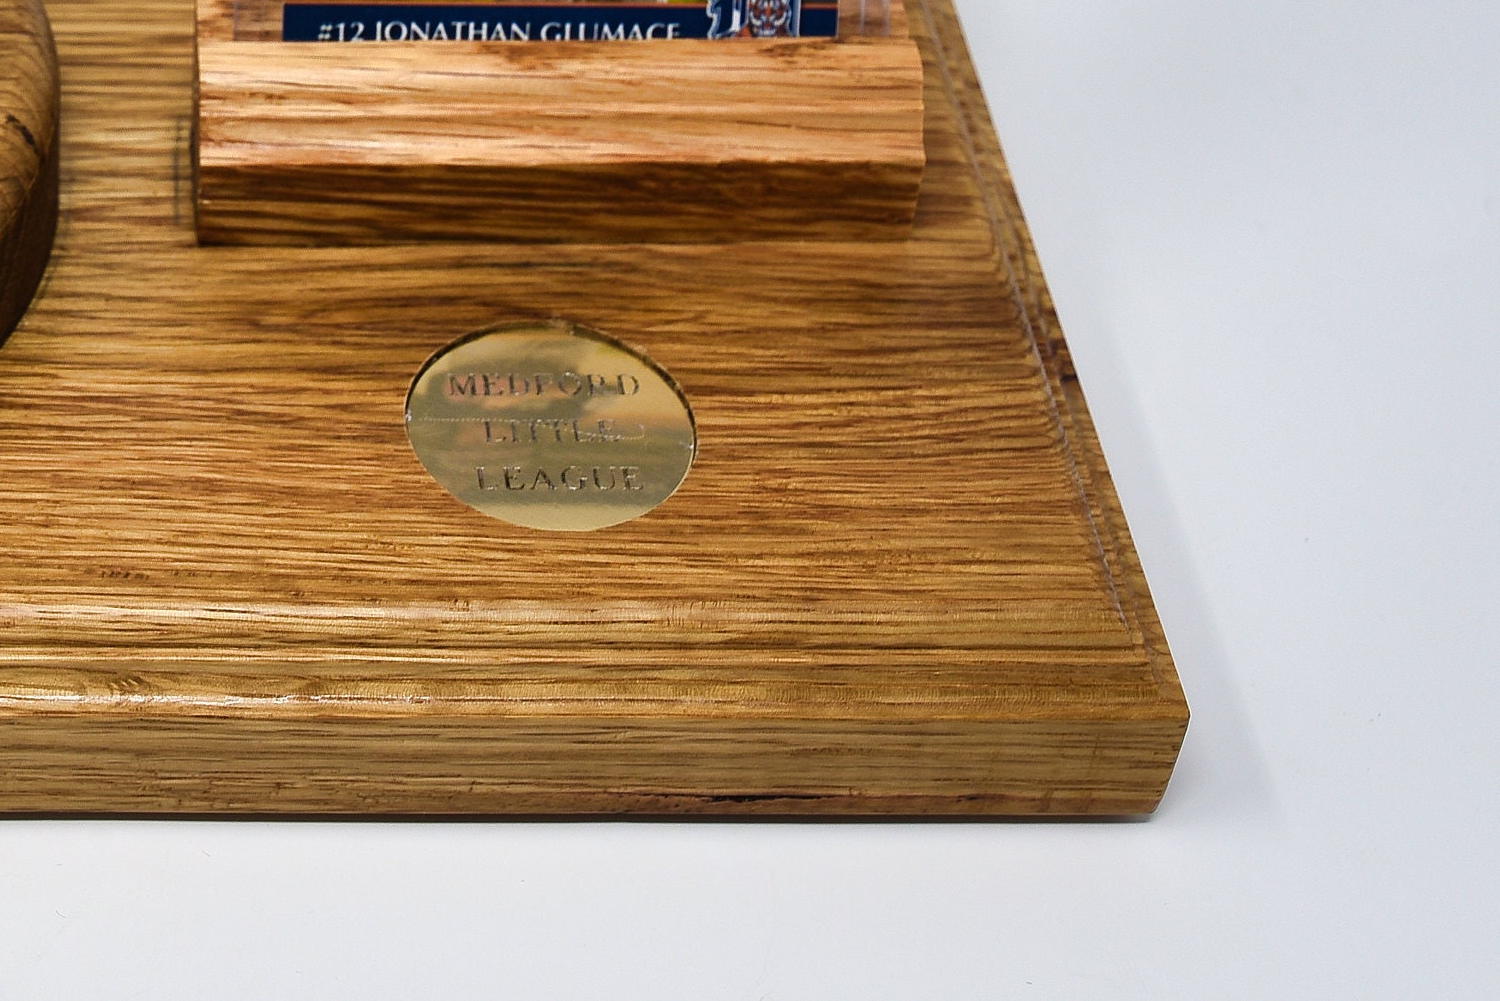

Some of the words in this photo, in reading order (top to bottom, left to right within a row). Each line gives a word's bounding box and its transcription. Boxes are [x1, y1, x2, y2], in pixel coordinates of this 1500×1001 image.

[317, 21, 365, 41] #12
[447, 371, 641, 397] MEDFORD
[482, 419, 621, 444] LITTLE
[475, 465, 645, 491] LEAGUE
